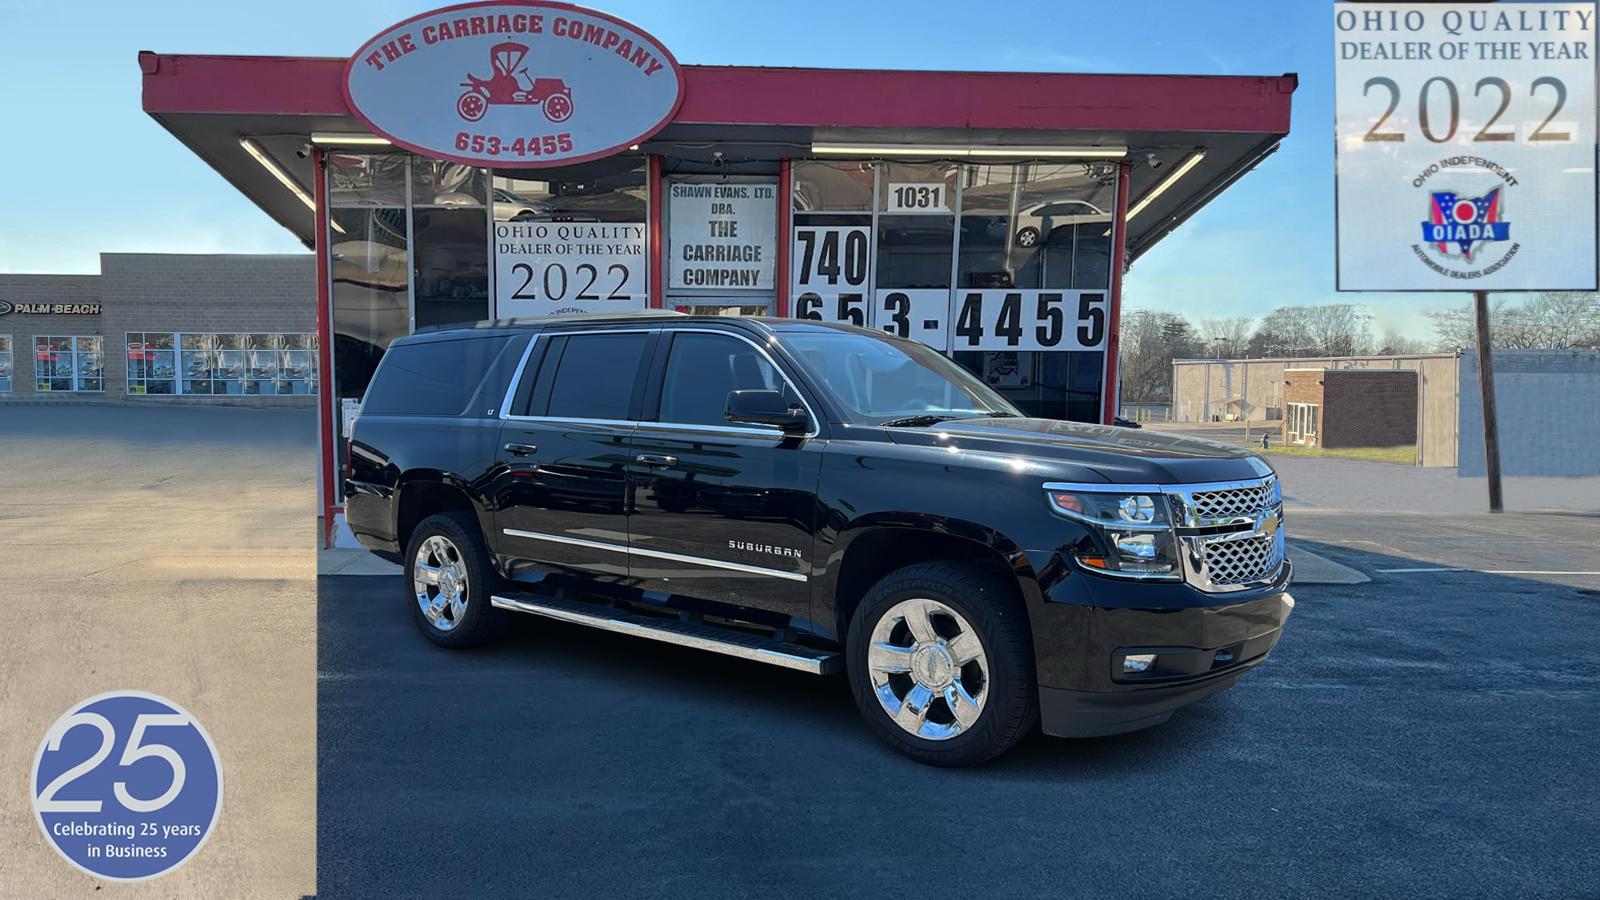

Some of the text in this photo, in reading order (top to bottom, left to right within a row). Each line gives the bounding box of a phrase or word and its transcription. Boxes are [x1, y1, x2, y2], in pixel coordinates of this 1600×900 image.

[1336, 10, 1593, 35] OHIO QUALITY
[366, 14, 664, 78] THE CARRIAGE COMPANY
[1340, 42, 1589, 60] DEALER OF THE YEAR
[1363, 76, 1571, 143] 2022
[455, 133, 573, 156] 653-4455
[1412, 155, 1519, 188] OHIO INDEPENDENT
[672, 186, 712, 198] SHAWN
[894, 186, 940, 208] 1031
[711, 203, 736, 215] DBA.
[497, 225, 645, 240] OHIO QUALITY
[708, 220, 738, 237] THE
[1433, 224, 1495, 240] OIADA
[499, 243, 642, 255] DEALER OF THE YEAR
[683, 244, 762, 262] CARRIAGE
[797, 230, 868, 286] 740
[1411, 242, 1521, 280] AUTOMOBILE DEALERS ASSOCIATION
[510, 262, 632, 300] 2022
[683, 268, 761, 286] COMPANY
[15, 303, 100, 314] PALM BEACH
[728, 540, 802, 558] SUBURBAN
